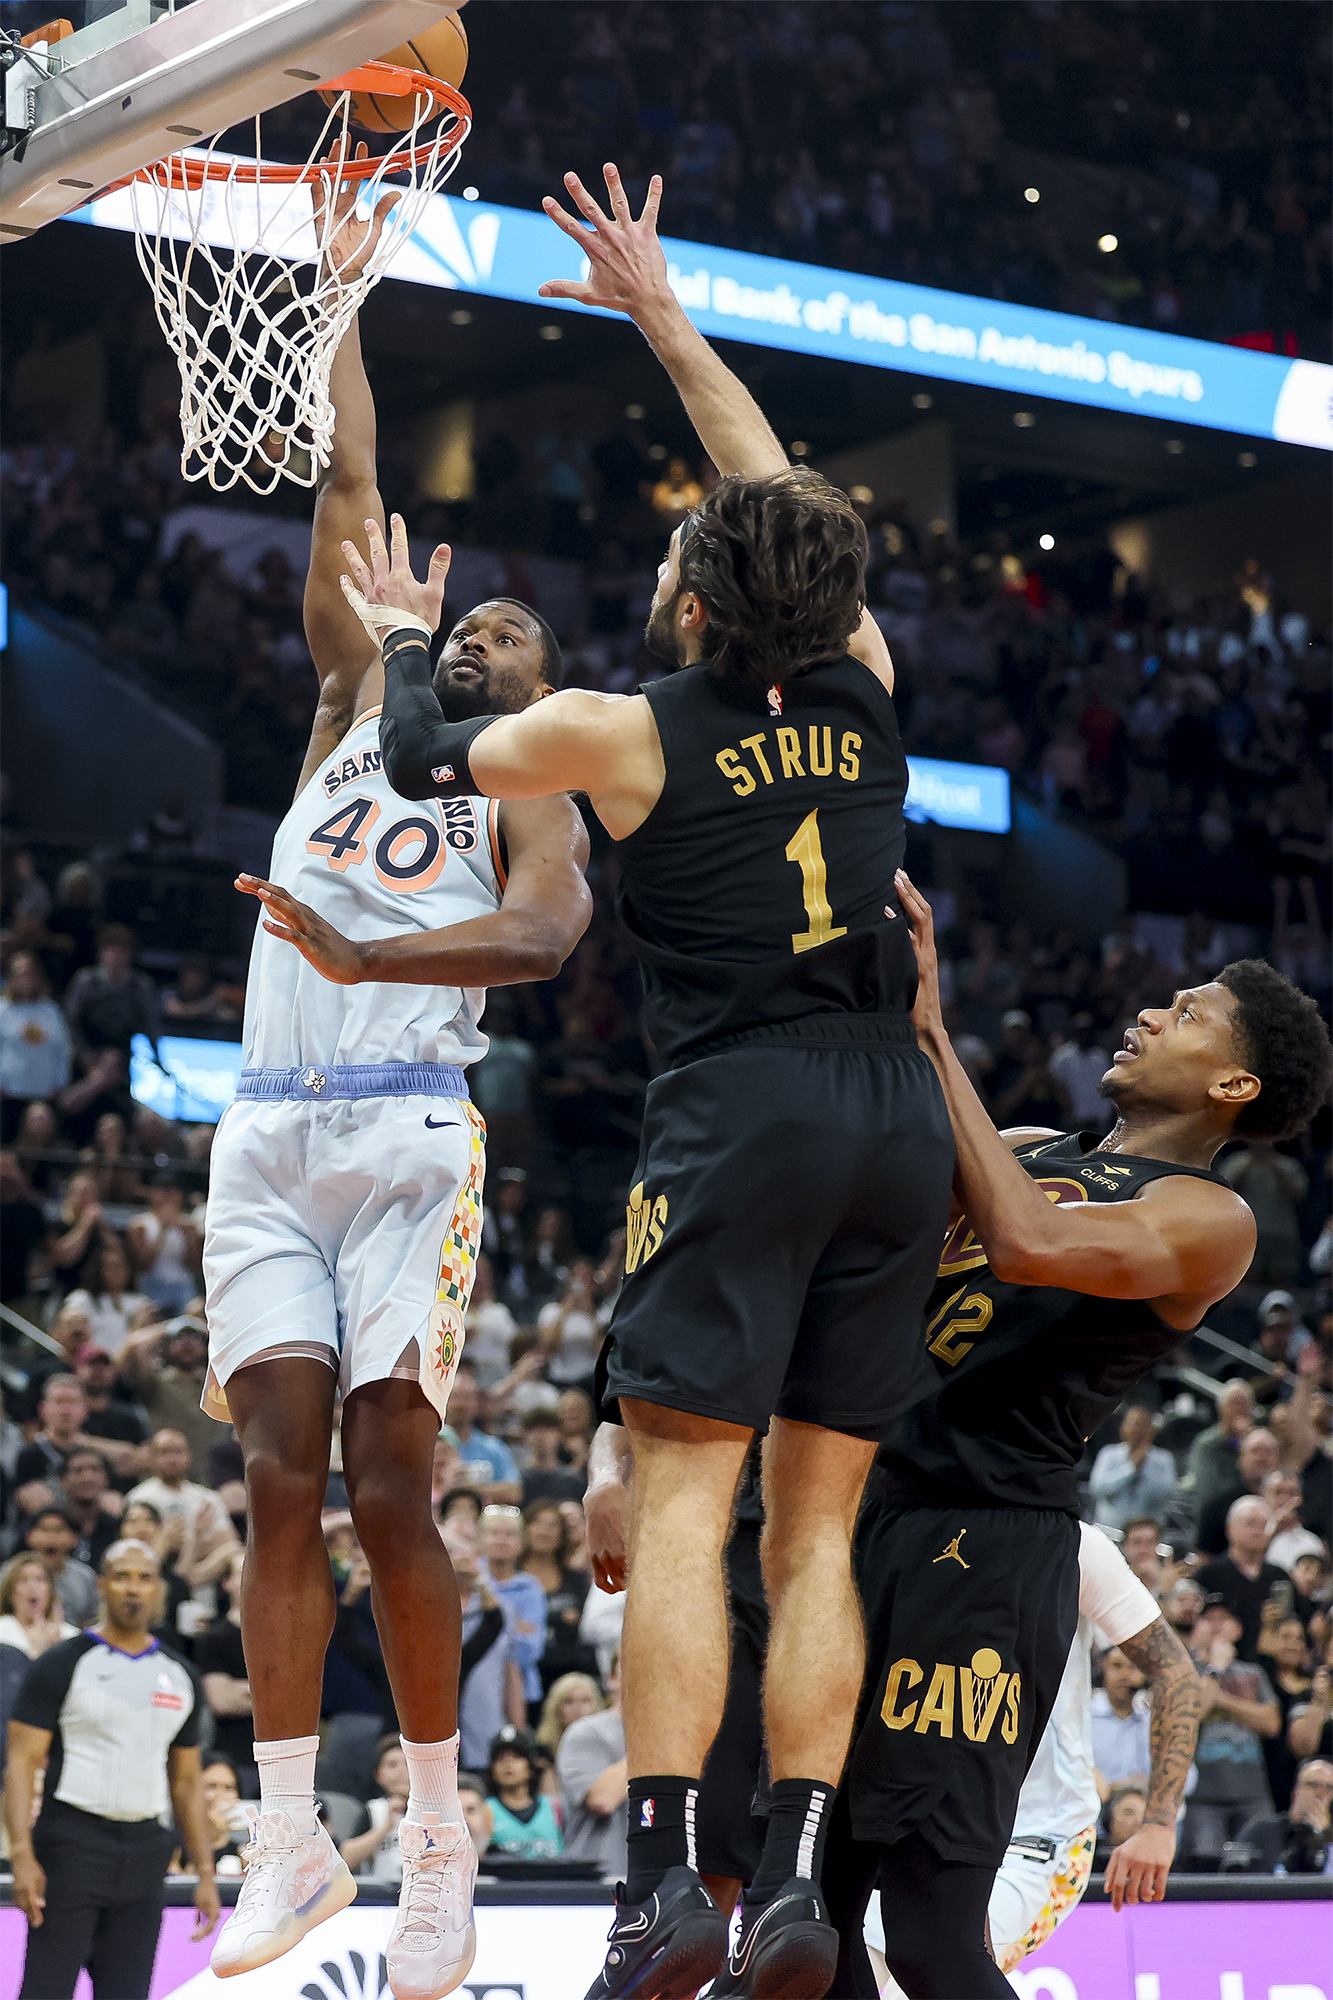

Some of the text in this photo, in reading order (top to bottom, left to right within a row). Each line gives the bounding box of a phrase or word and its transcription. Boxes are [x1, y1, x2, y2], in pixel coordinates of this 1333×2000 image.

[803, 290, 850, 335] of
[849, 300, 908, 347] the
[908, 313, 977, 360] San
[979, 327, 1106, 384] Antonio
[1107, 351, 1204, 402] Spurs
[322, 748, 384, 798] SAN
[716, 726, 862, 797] STRUS
[306, 796, 446, 892] 40
[785, 807, 848, 955] 1
[1080, 1168, 1119, 1191] CLIFFS
[880, 1656, 1021, 1745] CAVS
